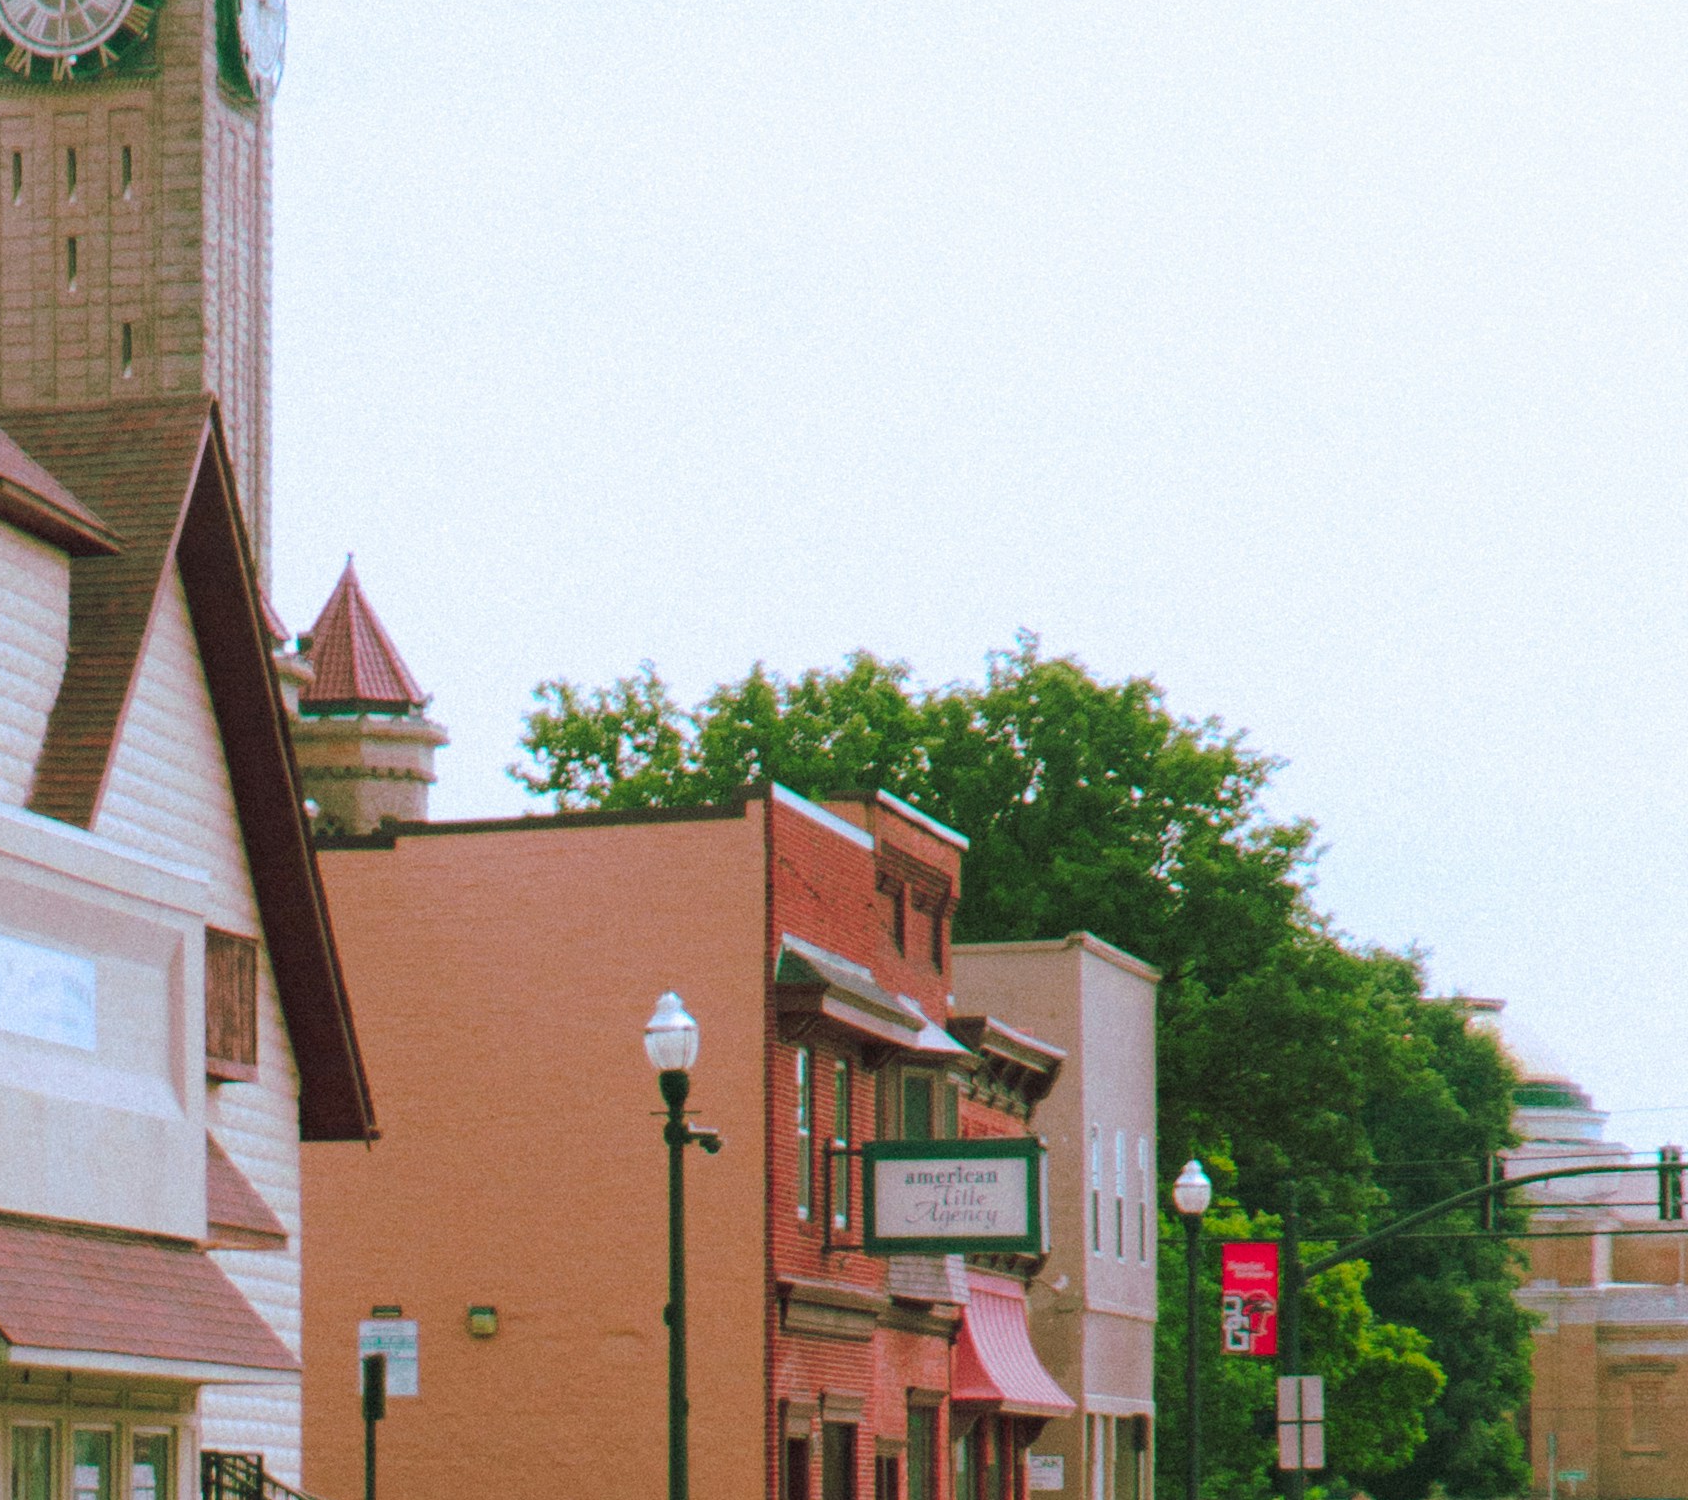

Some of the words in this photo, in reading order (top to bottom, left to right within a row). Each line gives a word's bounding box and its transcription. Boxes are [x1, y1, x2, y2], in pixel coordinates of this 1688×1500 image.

[905, 1165, 999, 1186] american
[933, 1184, 988, 1206] Title
[905, 1201, 999, 1230] Agency
